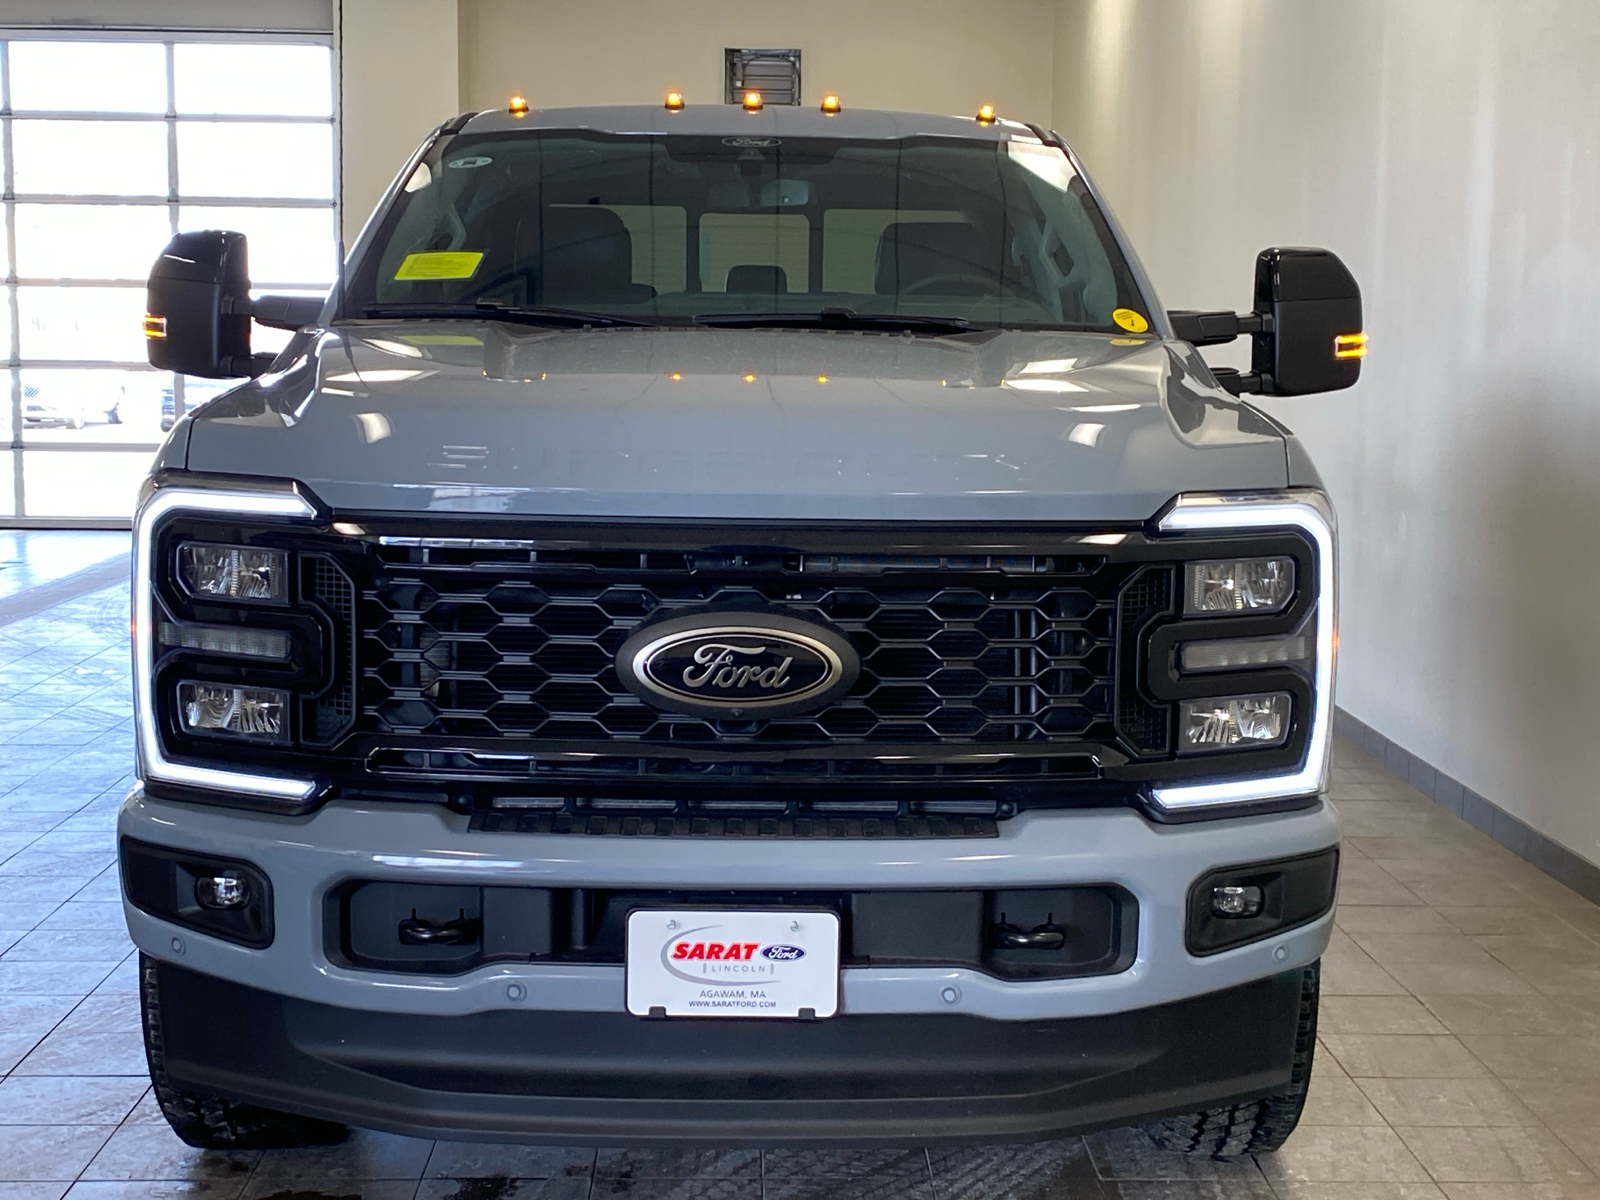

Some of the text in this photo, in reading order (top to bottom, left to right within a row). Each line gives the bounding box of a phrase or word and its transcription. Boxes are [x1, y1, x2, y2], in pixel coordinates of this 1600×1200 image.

[732, 137, 771, 146] Ford
[682, 643, 793, 688] Ford
[671, 942, 798, 961] SARAT Ford
[711, 964, 766, 973] LINCOLN
[699, 989, 766, 999] AGAWAM, MA
[688, 1000, 777, 1008] WWW.SARATFORD.COM
